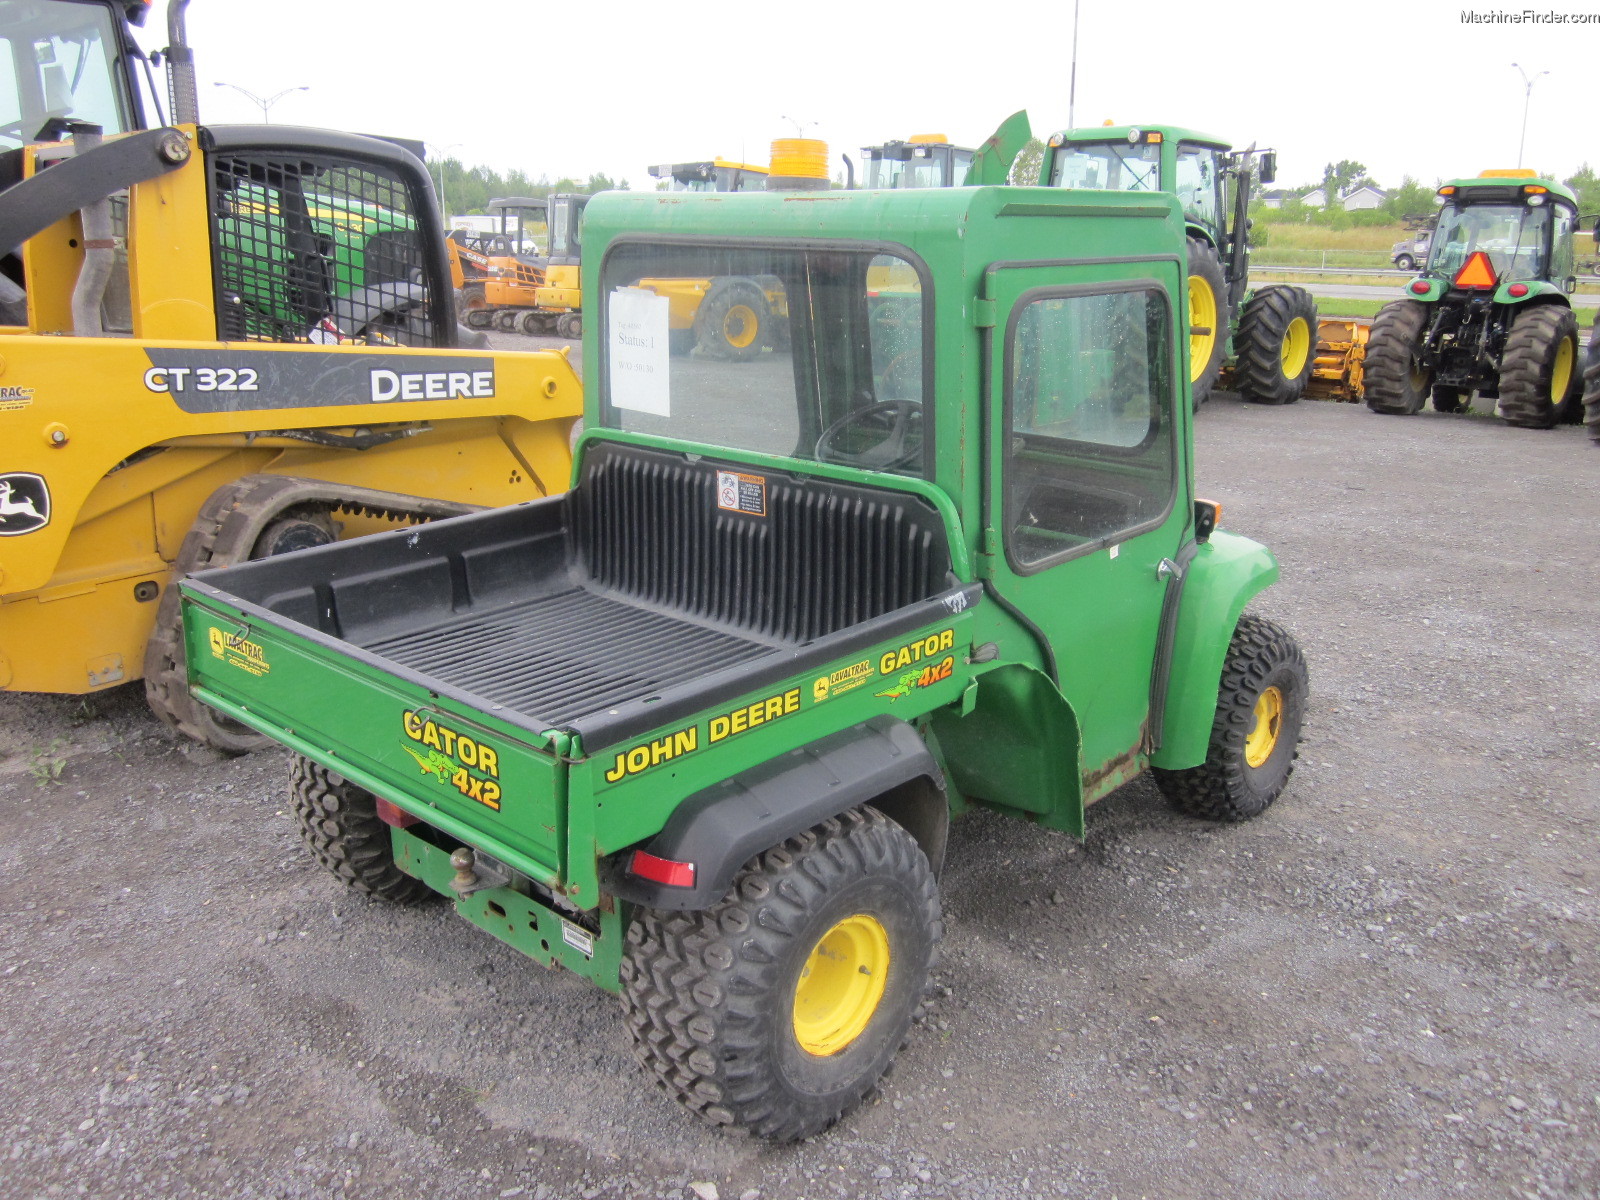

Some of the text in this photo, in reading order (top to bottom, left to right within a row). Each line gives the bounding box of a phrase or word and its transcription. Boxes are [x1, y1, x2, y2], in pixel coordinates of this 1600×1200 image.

[618, 332, 648, 348] Status:
[144, 366, 259, 393] CT 322
[370, 368, 494, 402] DEERE
[879, 628, 954, 676] GATOR
[830, 660, 870, 686] LAVALTRAC
[916, 655, 955, 688] 4x2
[403, 709, 500, 780] GATOR
[605, 686, 801, 784] JOHN DEERE
[451, 765, 501, 812] 4x2
